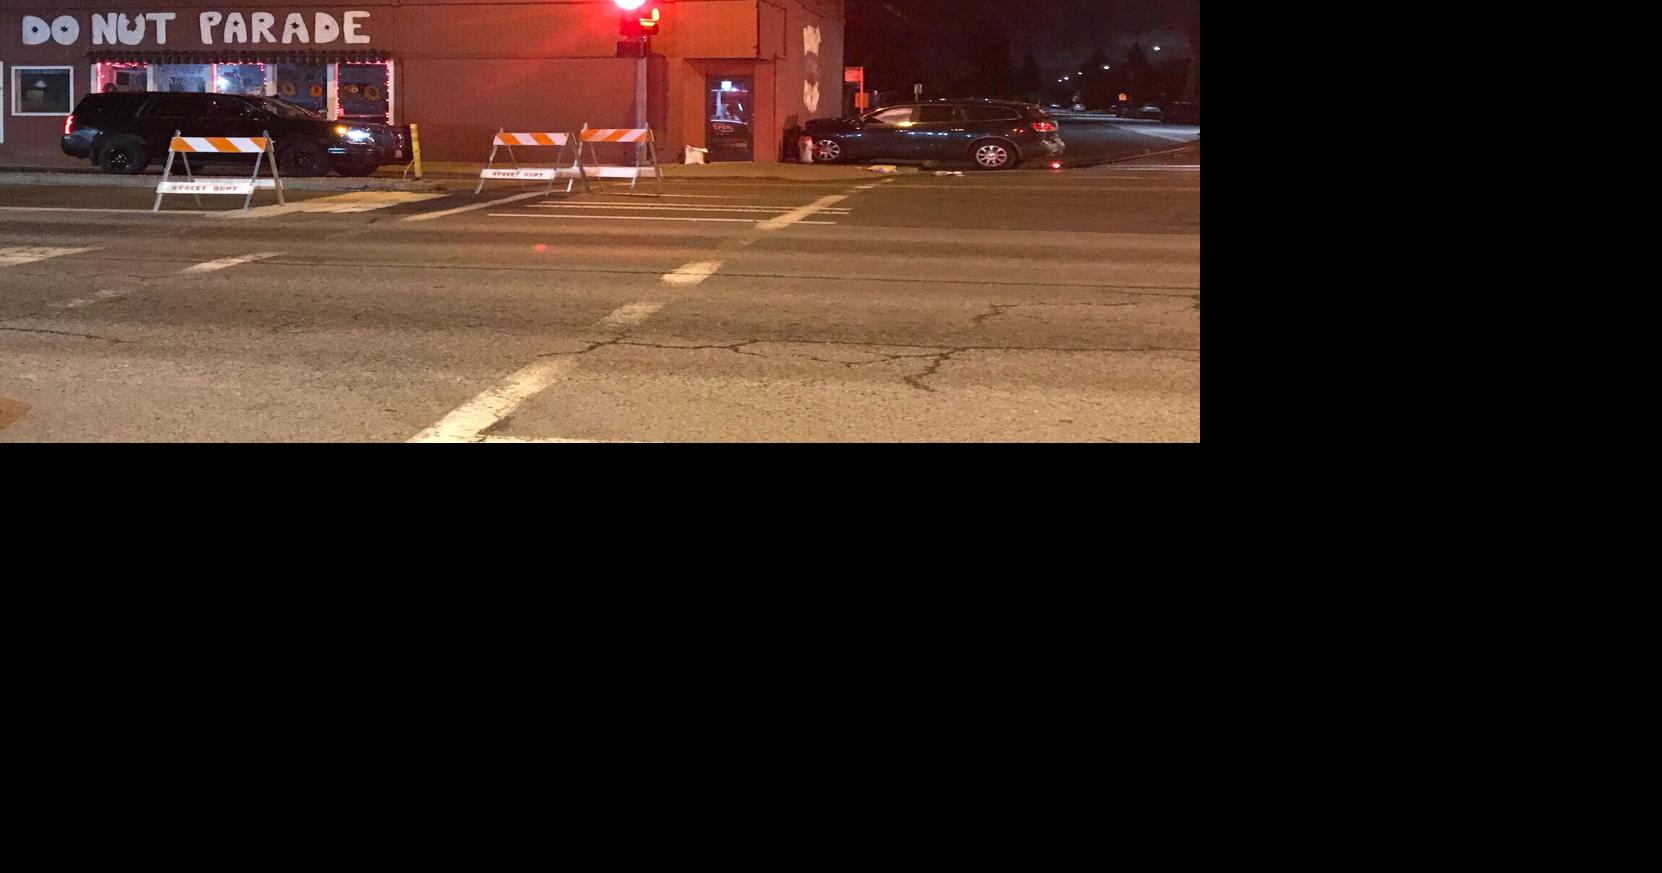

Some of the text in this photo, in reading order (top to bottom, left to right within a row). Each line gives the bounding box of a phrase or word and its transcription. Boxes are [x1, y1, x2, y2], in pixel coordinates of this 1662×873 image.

[22, 10, 370, 45] DO NUT PARADE
